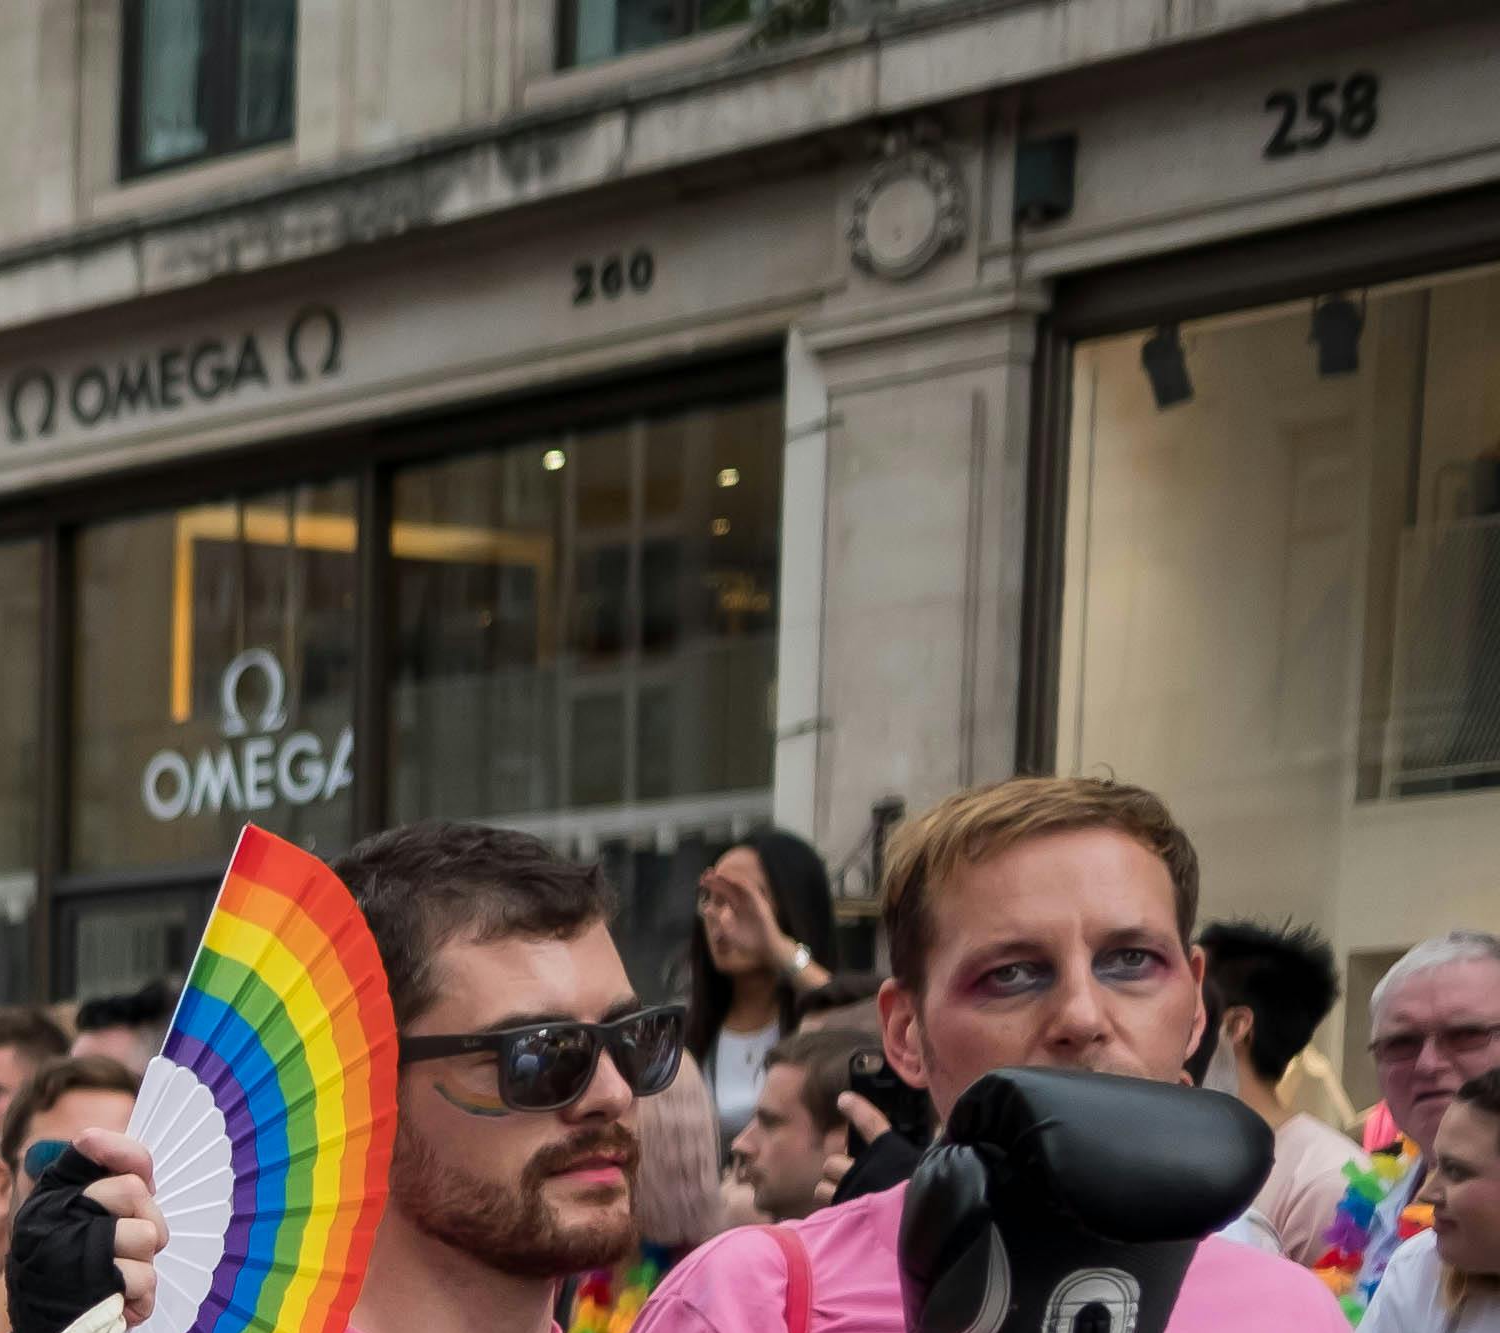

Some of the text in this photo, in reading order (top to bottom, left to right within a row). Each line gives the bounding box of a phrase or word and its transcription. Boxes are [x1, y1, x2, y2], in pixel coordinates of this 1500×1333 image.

[1262, 71, 1382, 160] 258
[572, 250, 654, 307] 260
[70, 332, 270, 430] OMEGA
